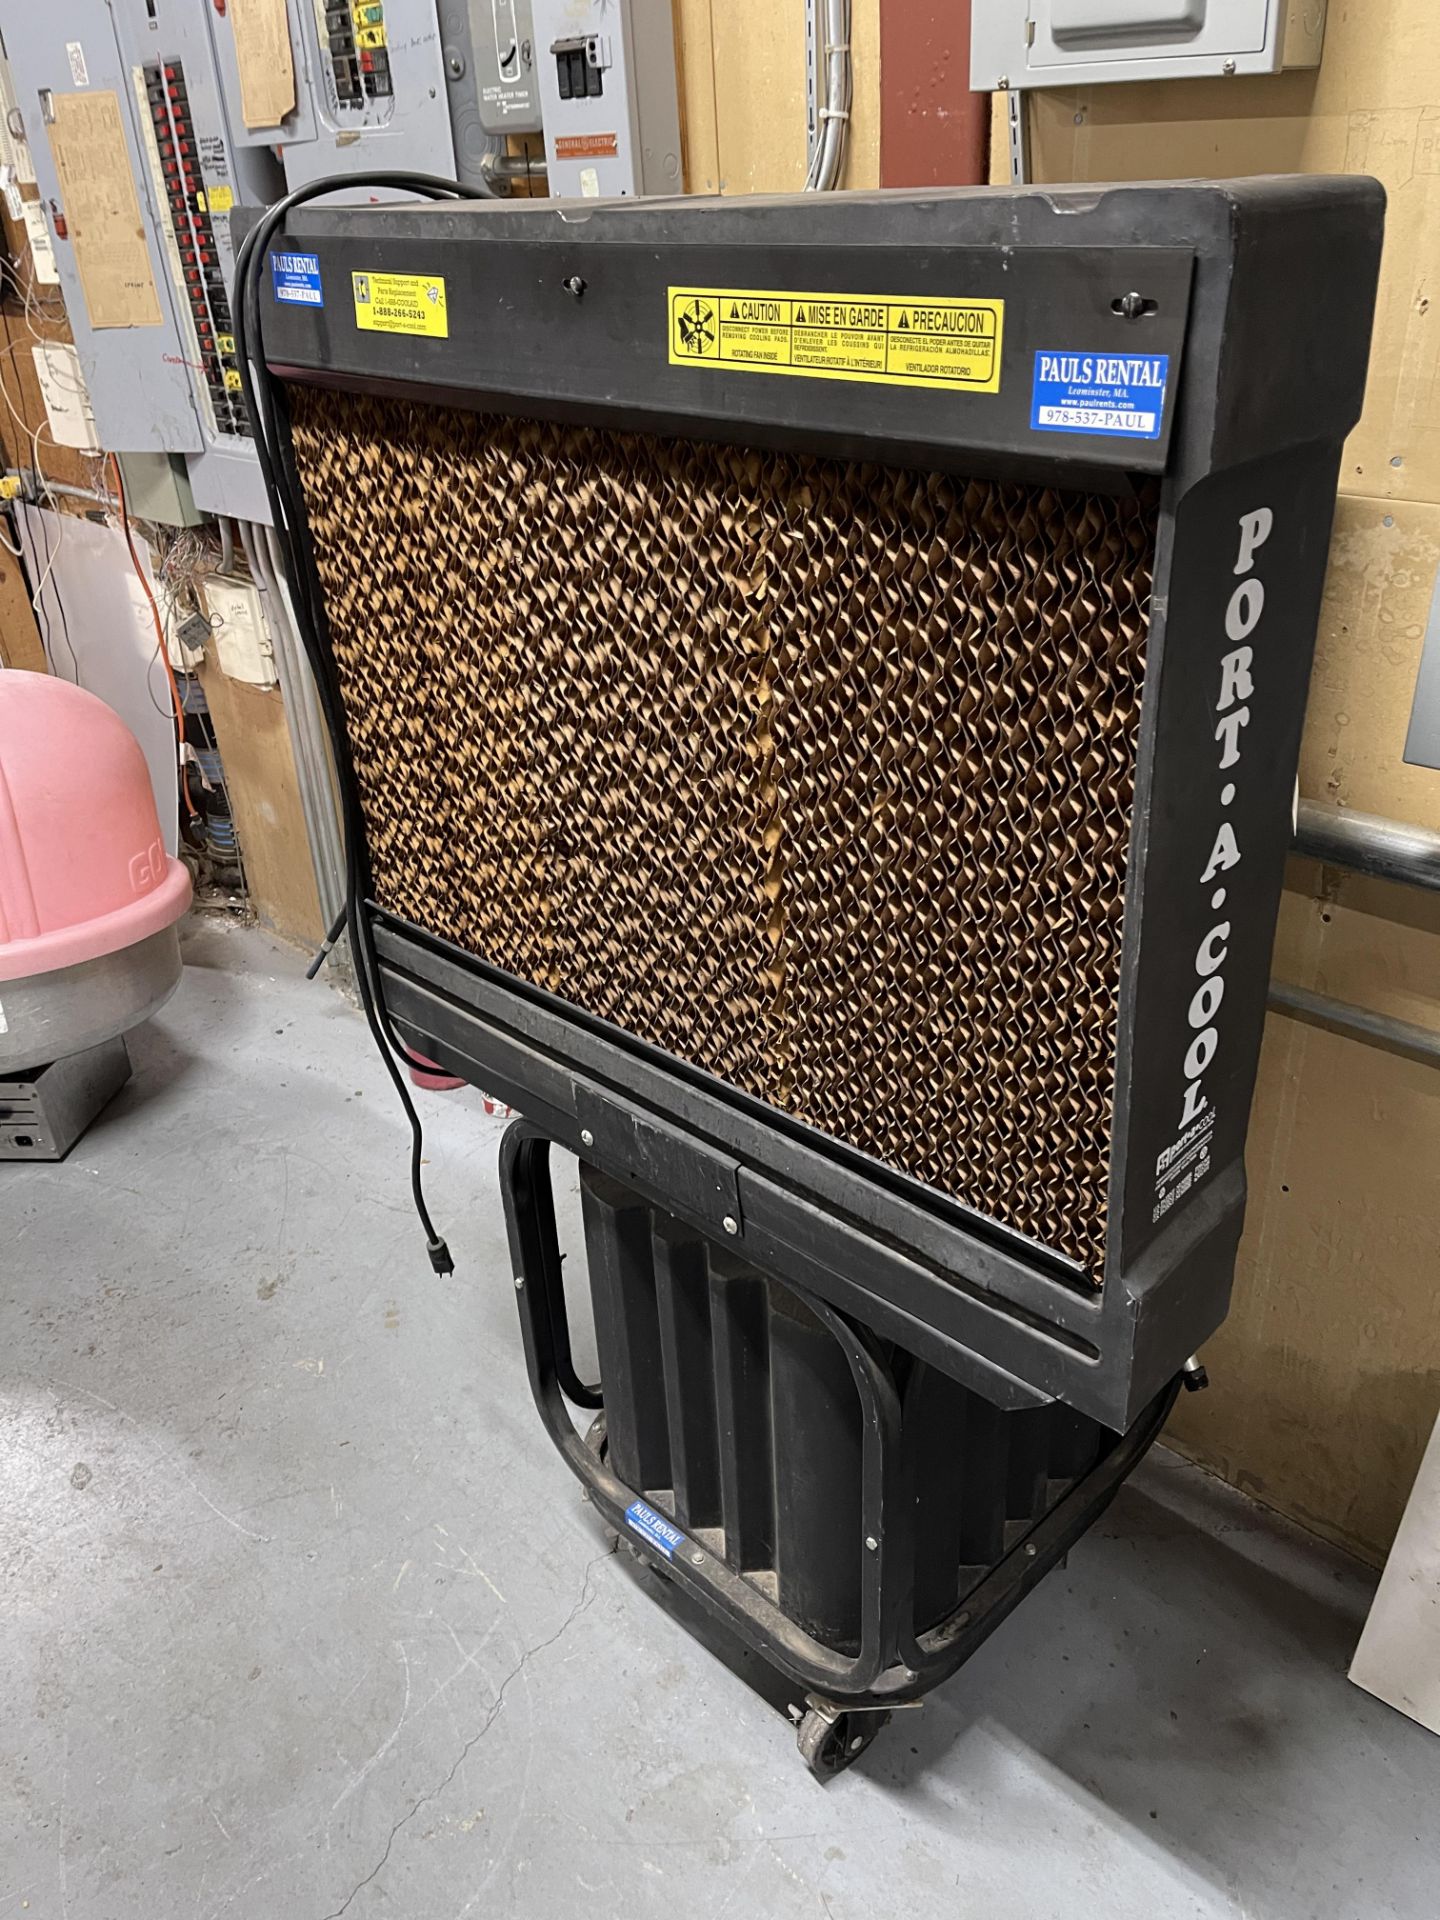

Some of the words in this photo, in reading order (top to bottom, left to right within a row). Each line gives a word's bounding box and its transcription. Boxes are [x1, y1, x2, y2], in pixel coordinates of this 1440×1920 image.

[558, 139, 581, 149] GENERAL
[273, 255, 292, 273] PAULS
[293, 256, 319, 274] RENTAL
[373, 307, 425, 319] 1-888-266-5243
[742, 302, 780, 321] CAUTION
[809, 306, 830, 324] MISE
[834, 307, 846, 325] EN
[849, 308, 884, 327] GARDE
[913, 311, 984, 333] PRECAUCION
[929, 338, 946, 346] PODER
[947, 339, 962, 347] ANTES
[732, 349, 752, 358] ROTATING
[754, 351, 762, 359] FAN
[763, 352, 777, 360] INSIDE
[906, 363, 938, 374] VENTILADOR
[940, 365, 971, 376] ROTATORIO
[1039, 357, 1092, 384] PAULS
[1095, 358, 1162, 387] RENTAL
[1060, 398, 1135, 409] www.paulrents.com
[1046, 409, 1146, 429] 978-537-PAUL
[631, 1503, 656, 1525] PAULS
[650, 1519, 681, 1546] RENTAL
